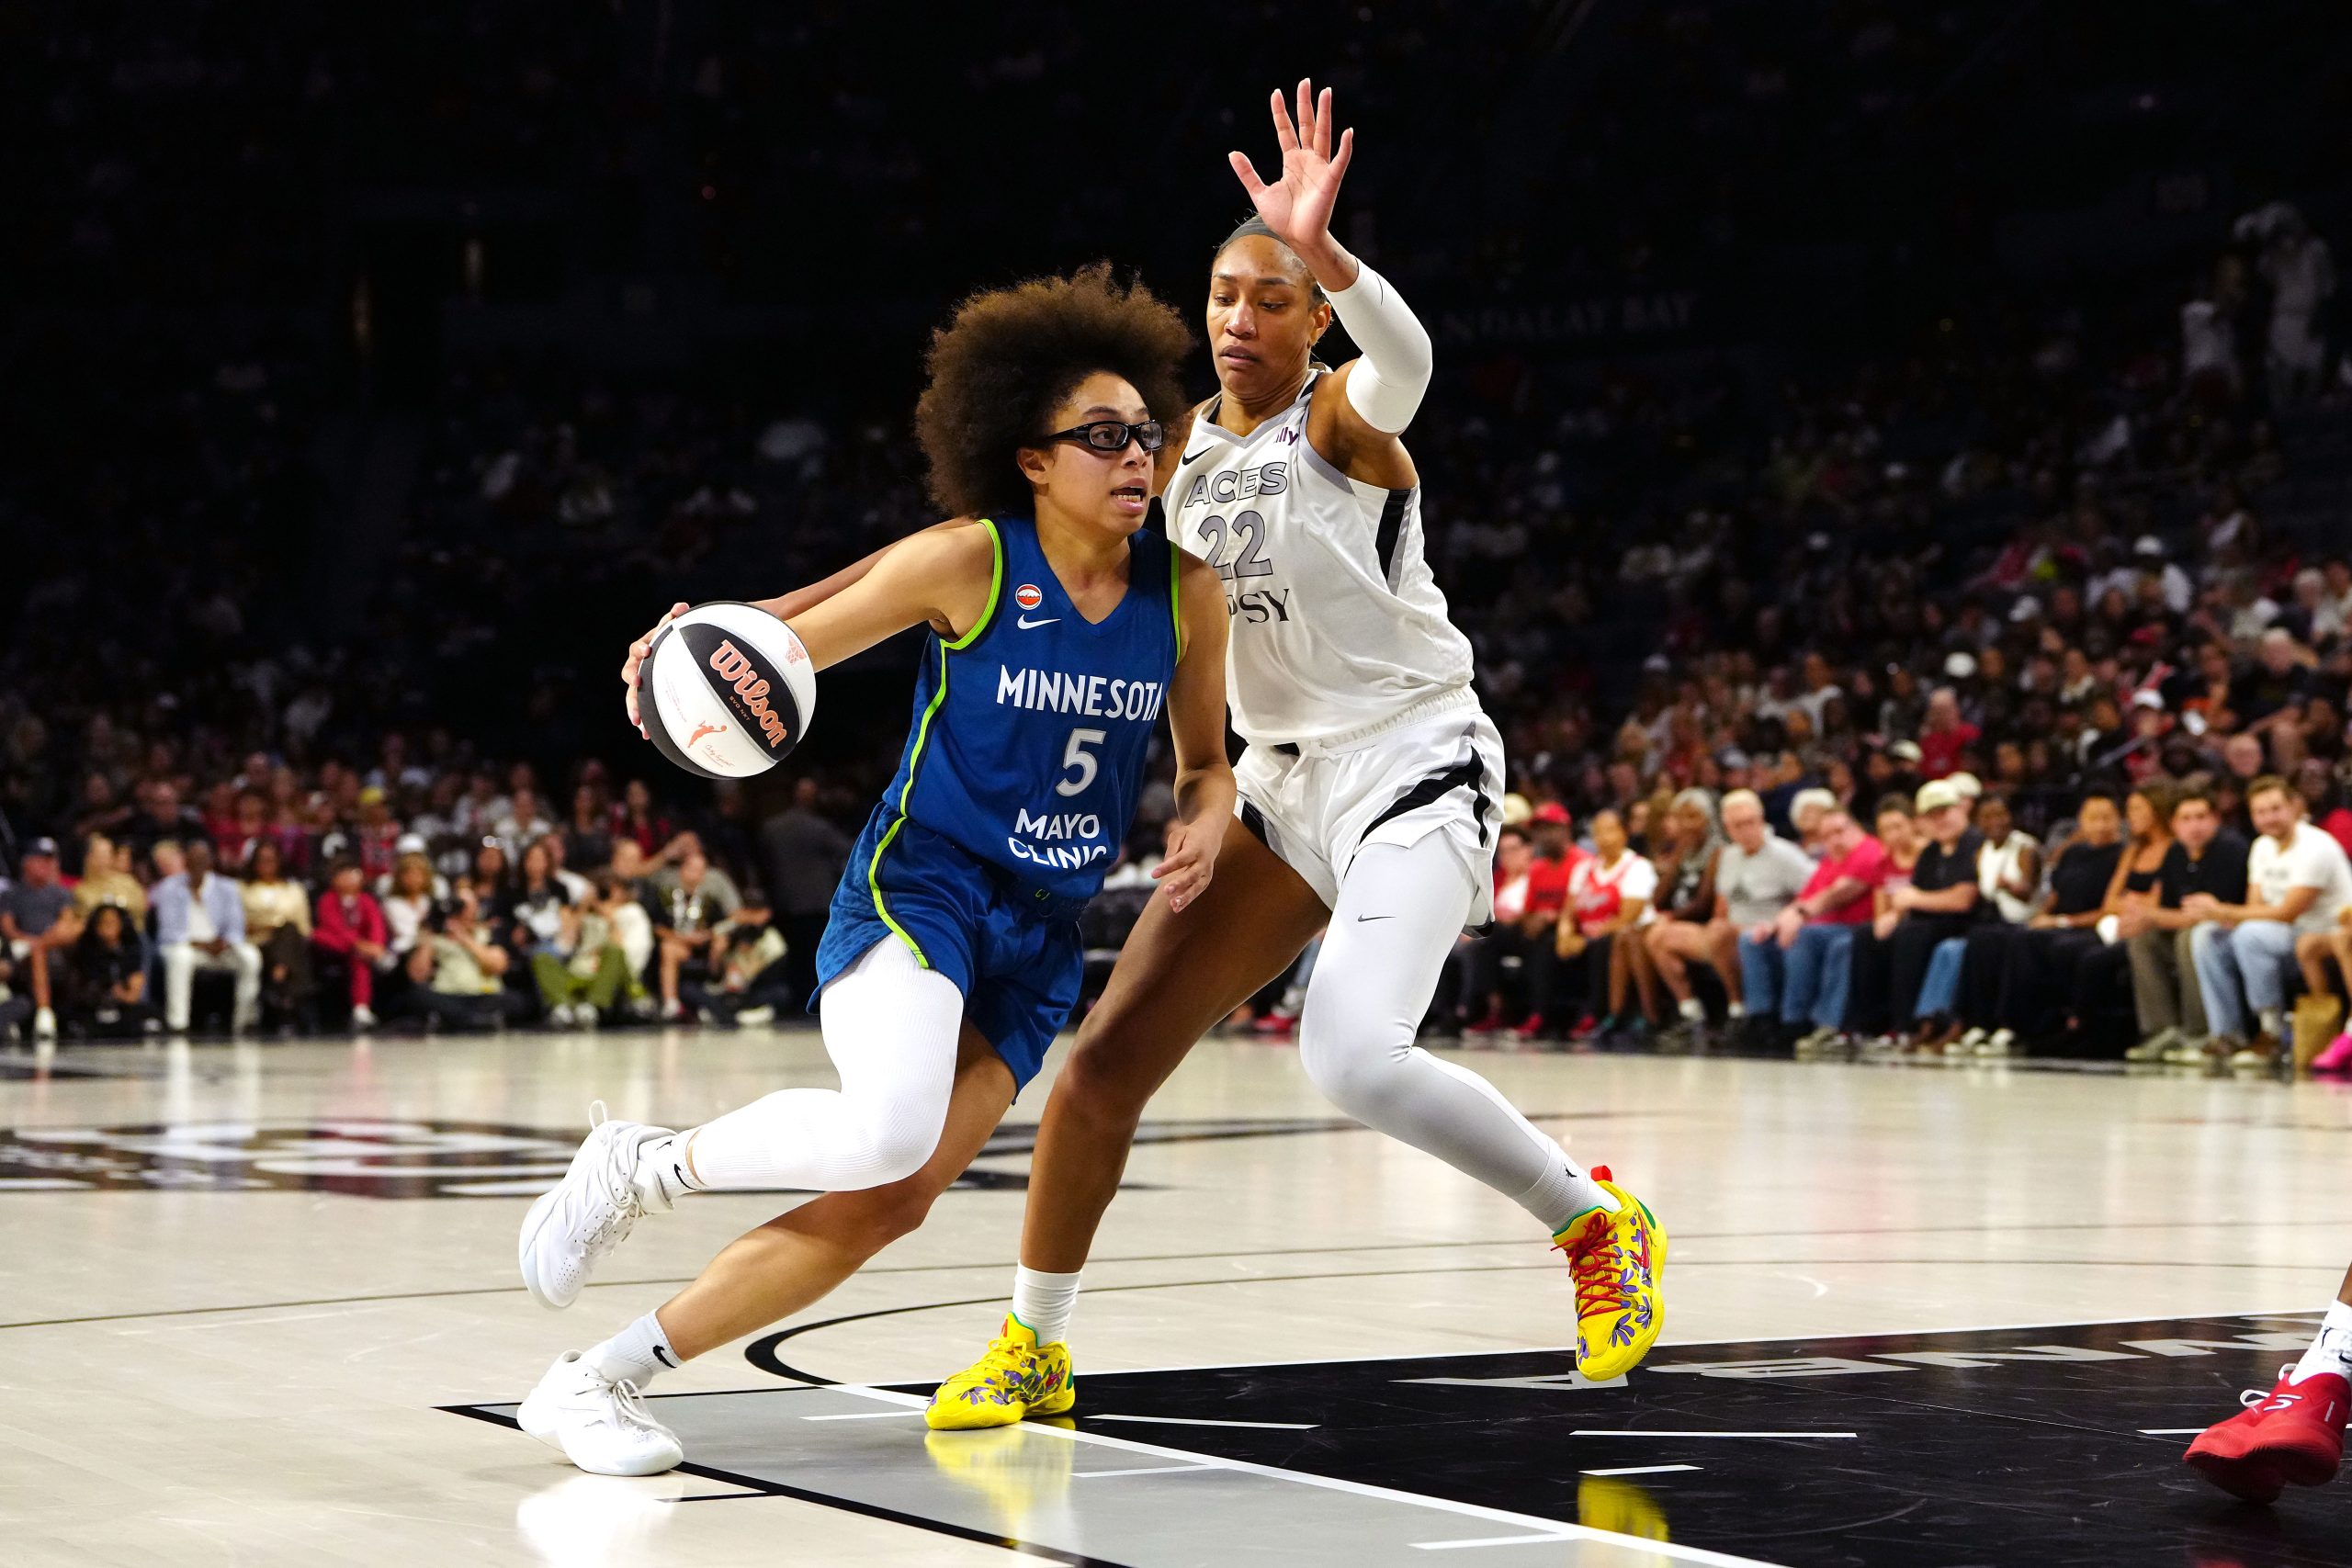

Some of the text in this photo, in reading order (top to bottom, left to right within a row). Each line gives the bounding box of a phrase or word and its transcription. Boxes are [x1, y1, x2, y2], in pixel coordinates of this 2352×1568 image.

[1184, 461, 1288, 508] ACES
[1197, 510, 1273, 581] 22
[709, 638, 787, 749] Wilson
[996, 664, 1163, 721] MINNESOTA
[1055, 728, 1107, 797] 5
[1014, 807, 1100, 840] MAYO
